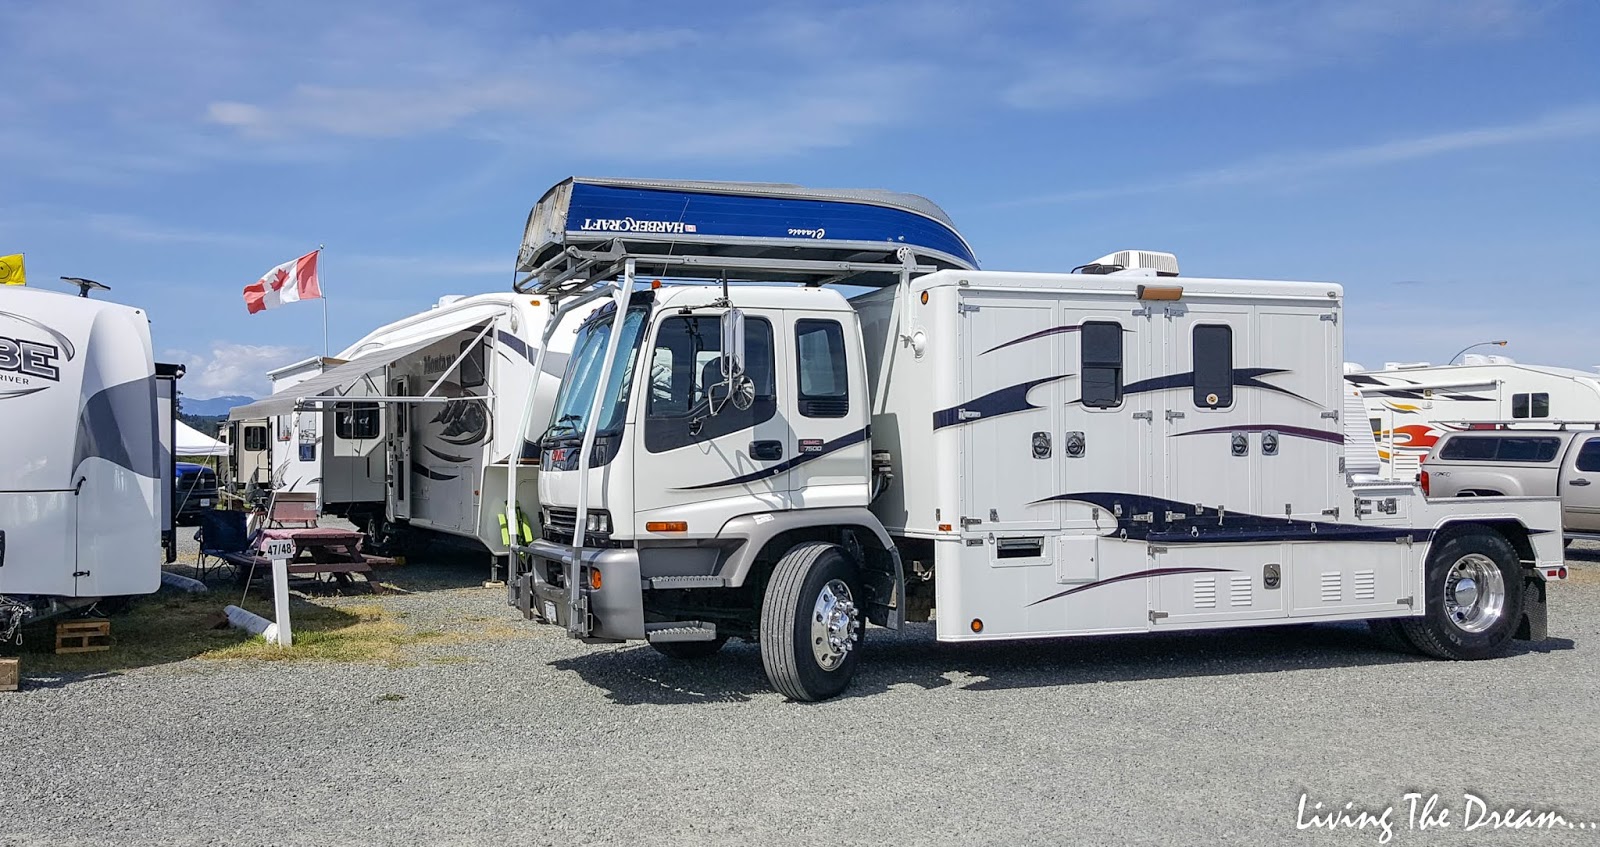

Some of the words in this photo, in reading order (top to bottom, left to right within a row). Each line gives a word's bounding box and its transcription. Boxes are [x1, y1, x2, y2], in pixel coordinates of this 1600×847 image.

[580, 217, 685, 233] HARBERCRAFT
[788, 228, 825, 239] Classic
[267, 543, 292, 556] 47/48
